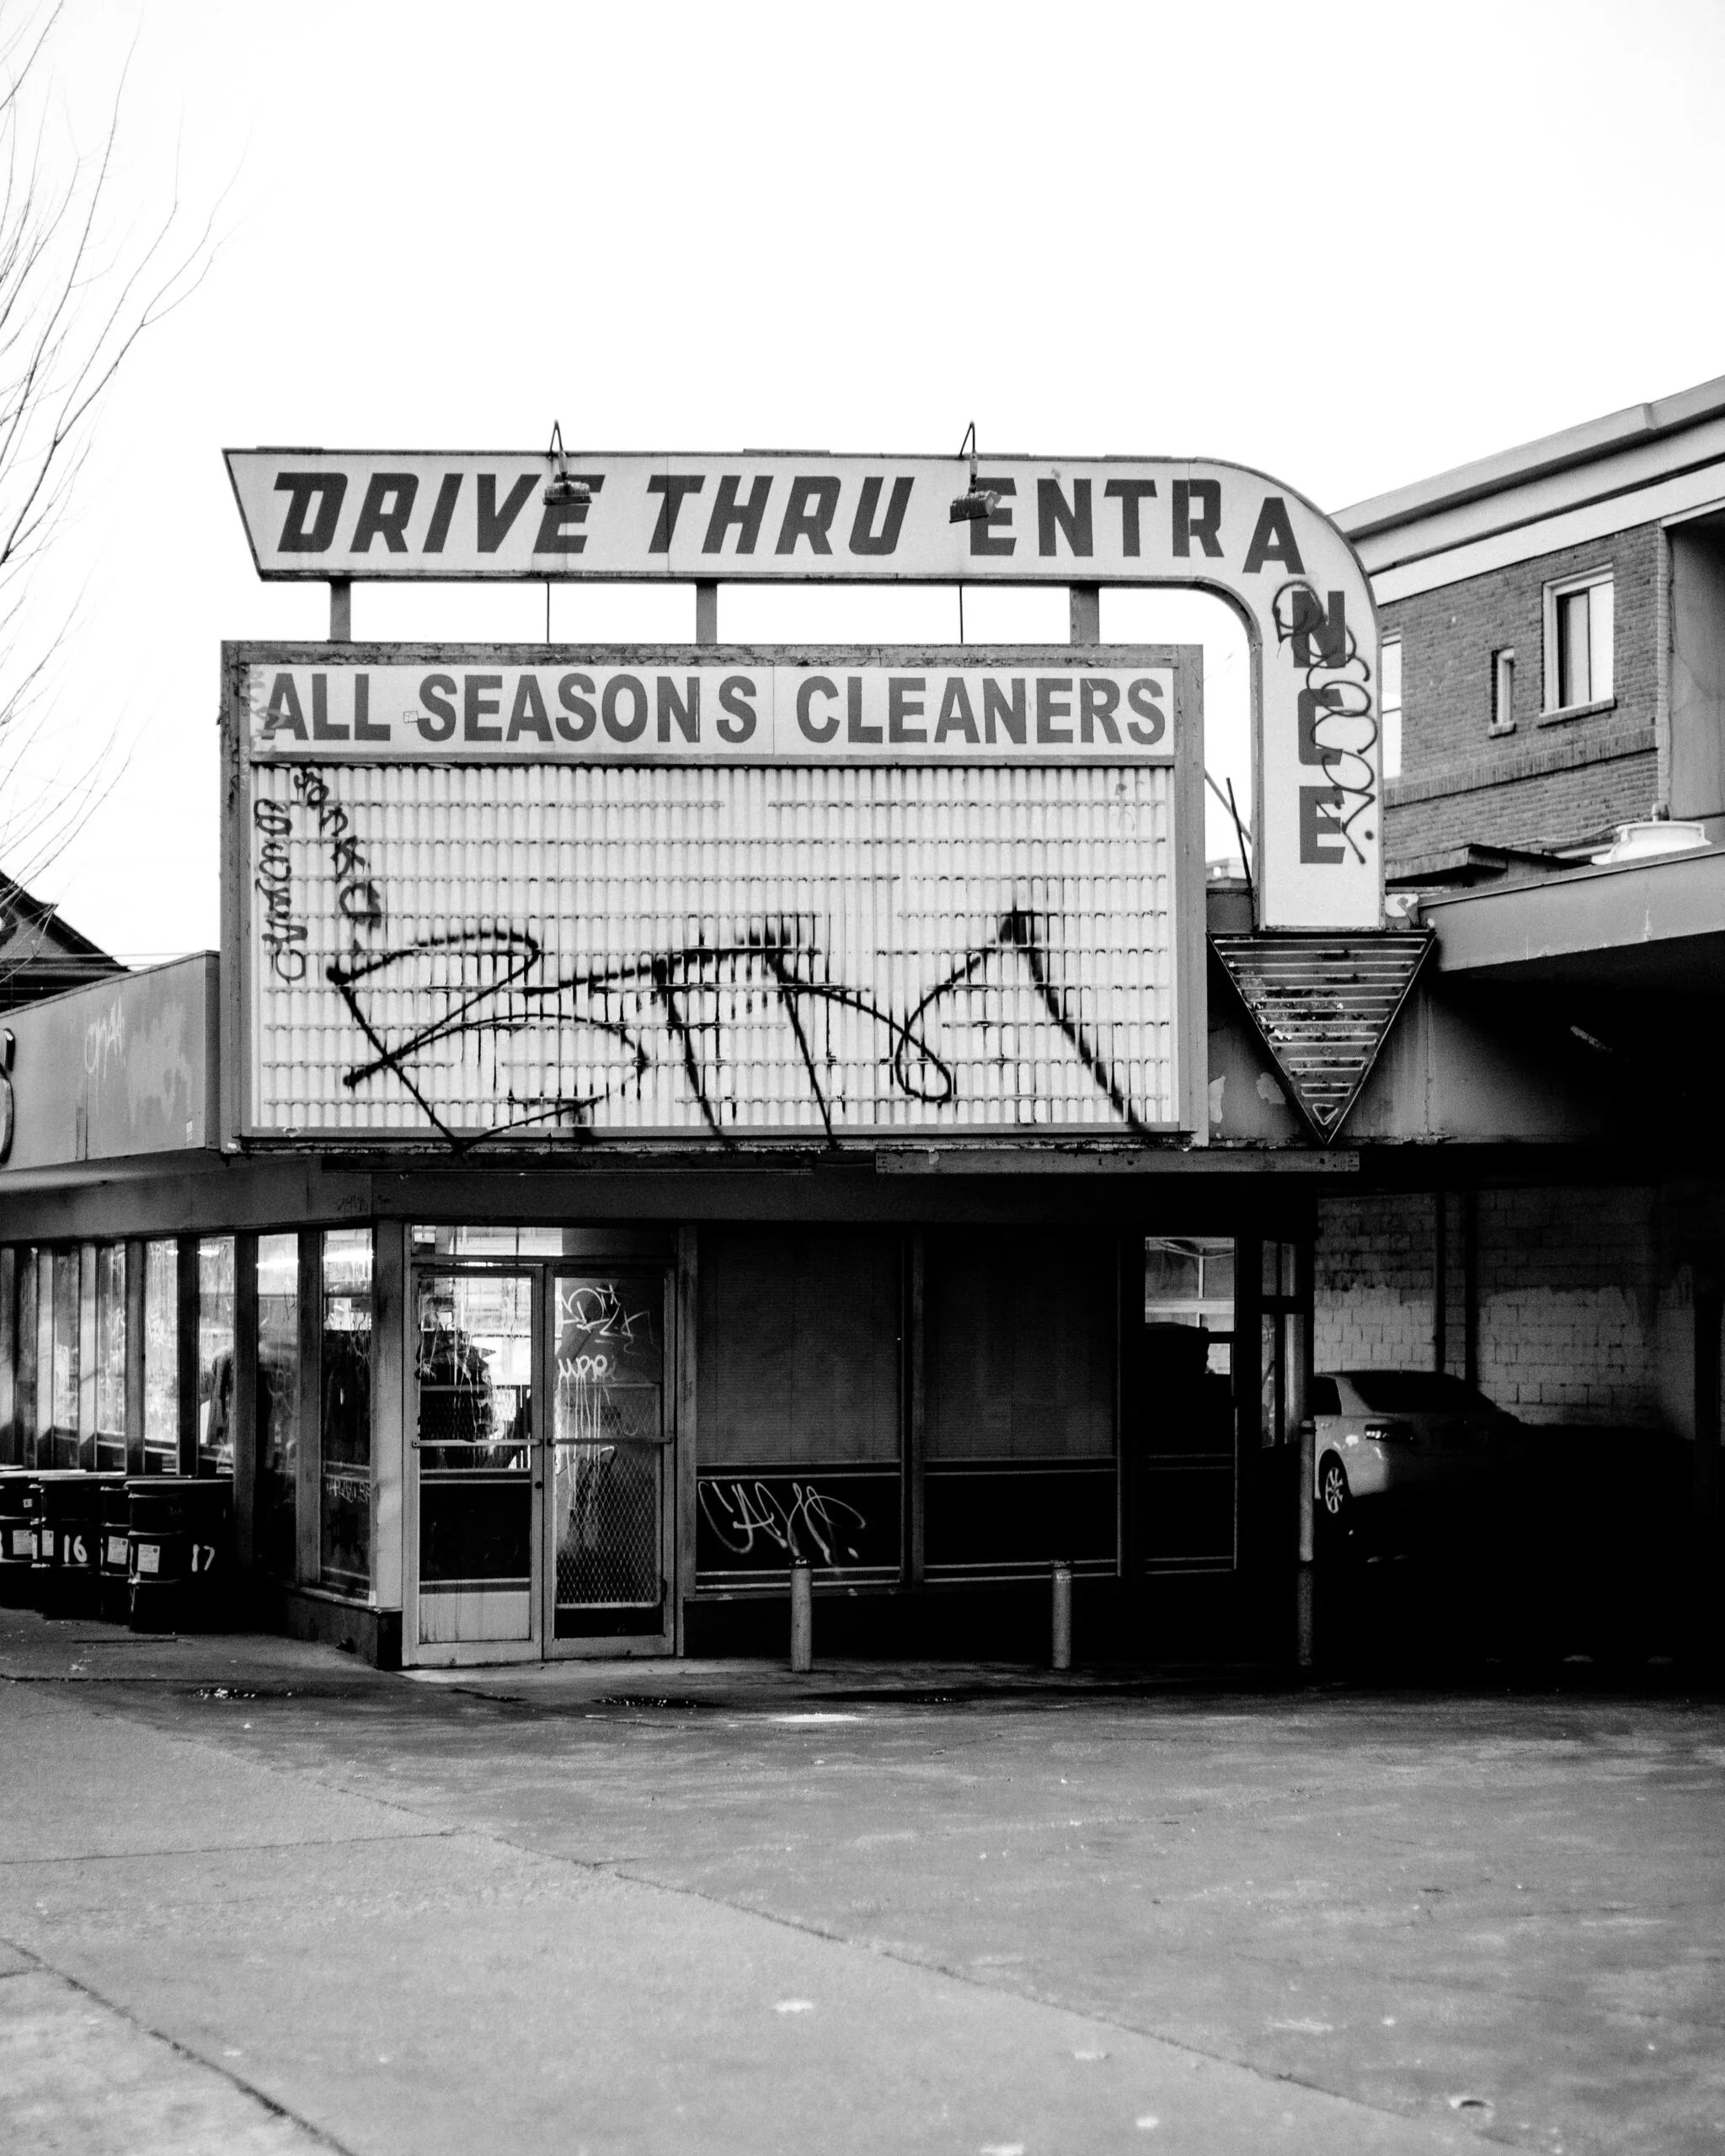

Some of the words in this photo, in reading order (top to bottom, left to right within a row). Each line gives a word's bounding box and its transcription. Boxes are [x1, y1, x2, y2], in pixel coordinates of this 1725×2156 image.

[273, 472, 606, 553] DRIVE
[646, 474, 916, 556] THRU
[969, 477, 1346, 865] ENTRANCE
[260, 673, 392, 742] ALL
[418, 673, 757, 744] SEASONS
[796, 675, 1167, 745] CLEANERS
[64, 1534, 88, 1564] 16
[191, 1544, 216, 1573] 17
